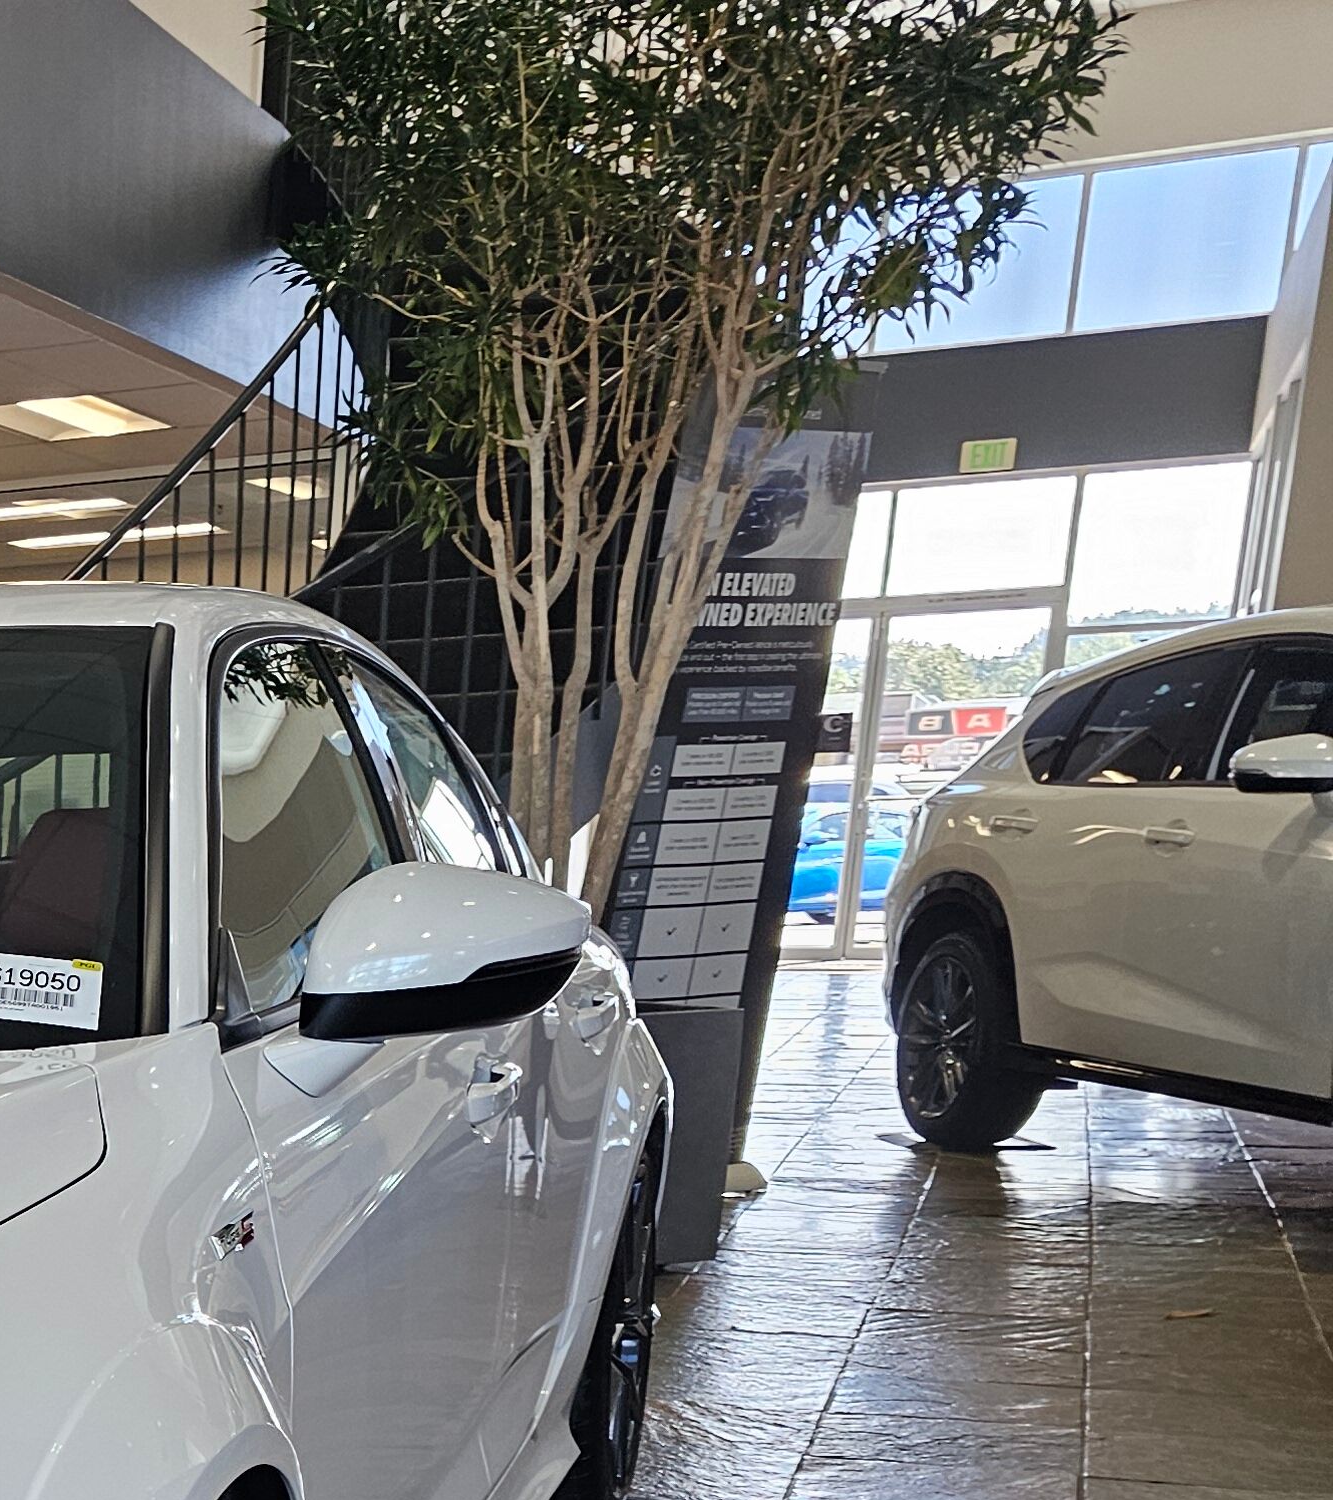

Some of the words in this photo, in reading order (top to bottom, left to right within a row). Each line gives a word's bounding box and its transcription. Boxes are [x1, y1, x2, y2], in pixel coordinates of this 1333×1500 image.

[969, 441, 1008, 468] EXIT
[721, 572, 796, 597] ELEVATED
[744, 602, 836, 627] EXPERIENCE
